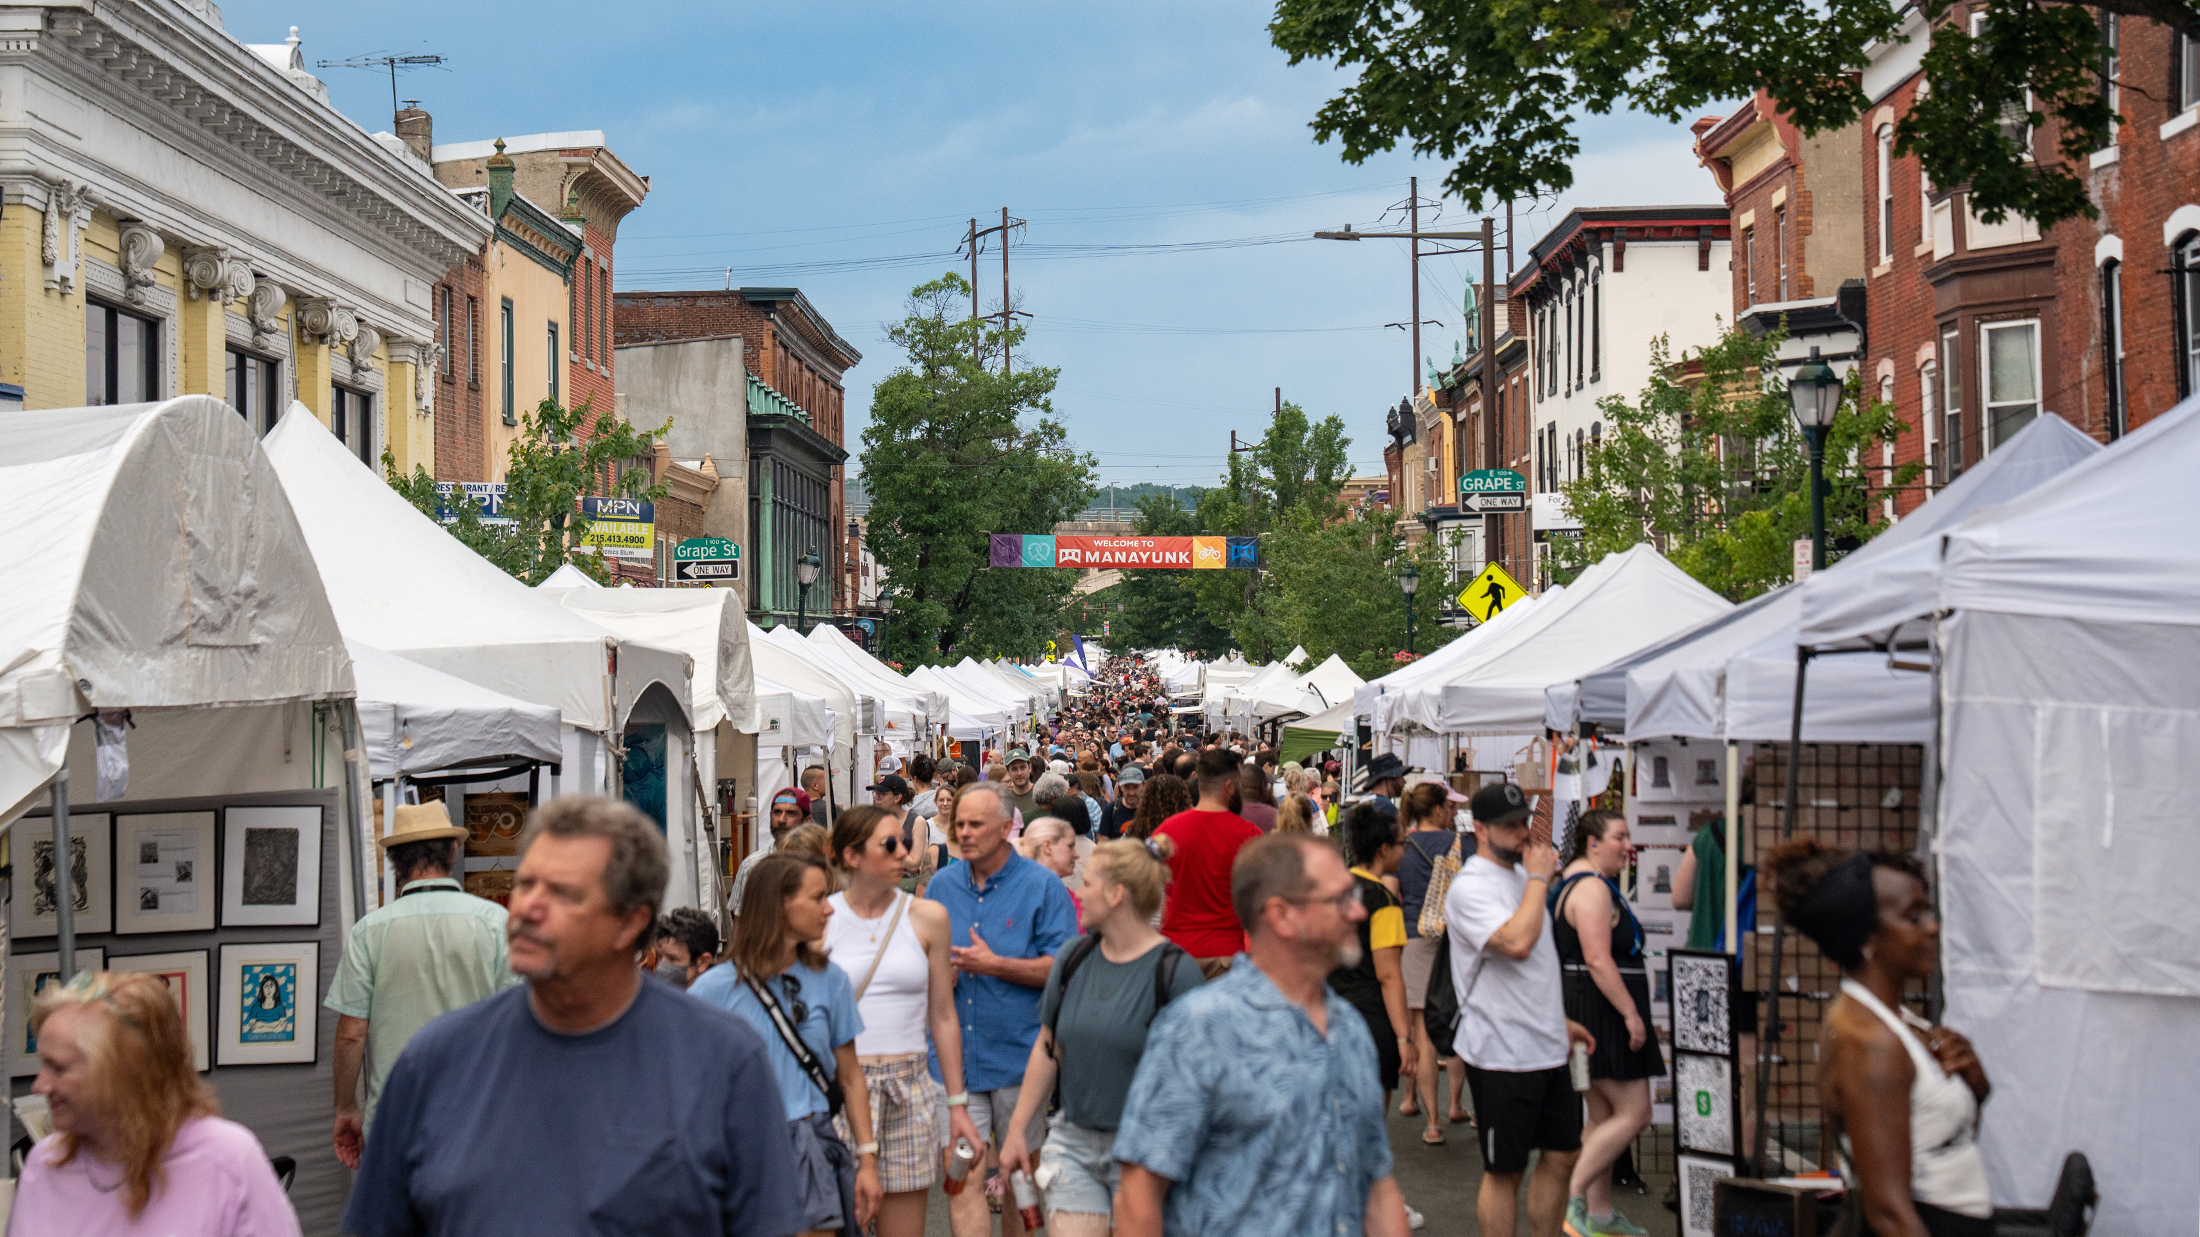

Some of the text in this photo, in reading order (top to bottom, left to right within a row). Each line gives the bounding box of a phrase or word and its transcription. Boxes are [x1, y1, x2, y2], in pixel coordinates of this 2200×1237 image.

[1489, 469, 1494, 477] E
[435, 483, 488, 493] RESTURANT
[1462, 477, 1525, 491] GRAPE ST
[1480, 498, 1519, 507] ONE WAY
[1548, 495, 1561, 504] For
[597, 499, 640, 514] MPN
[590, 534, 645, 544] 215.413.4900
[1093, 539, 1139, 547] WELCOME
[677, 543, 737, 560] Grape St
[1085, 550, 1191, 564] MANAYUNK
[693, 565, 730, 575] ONE WAY
